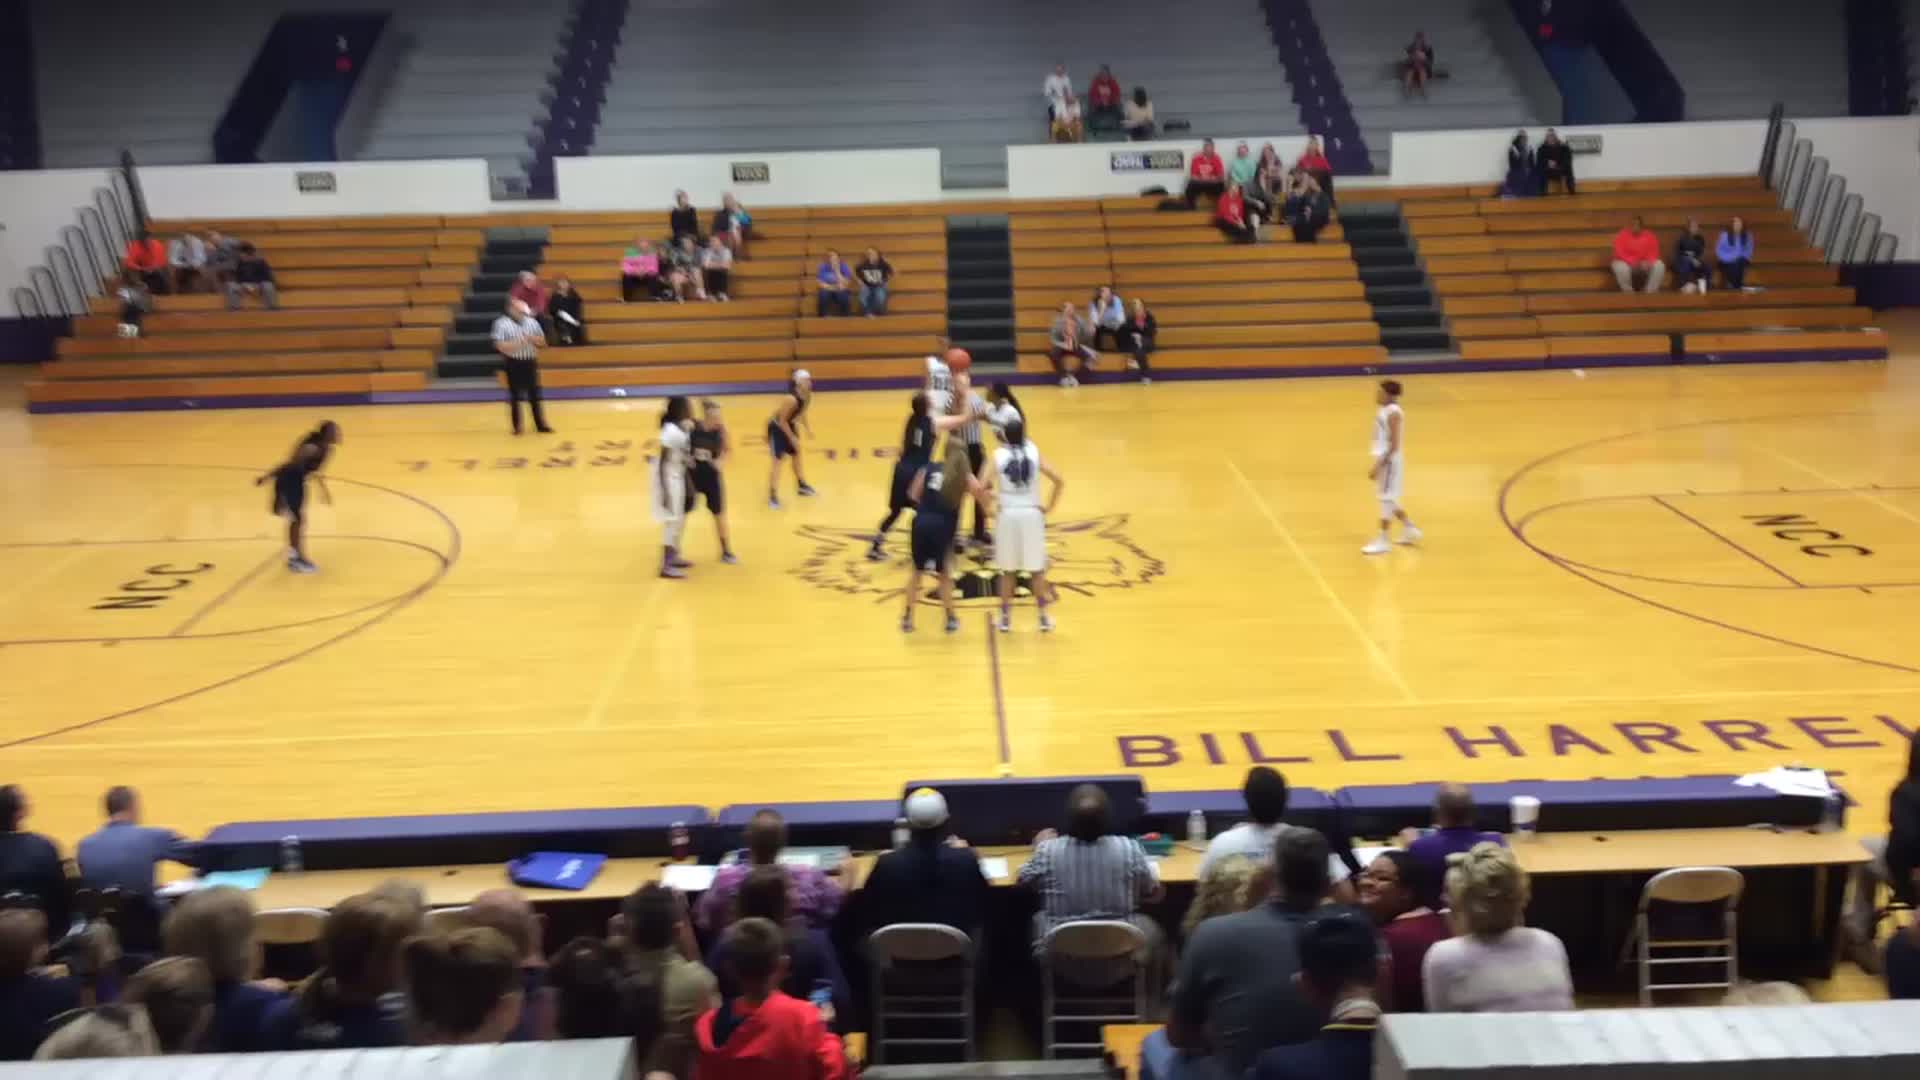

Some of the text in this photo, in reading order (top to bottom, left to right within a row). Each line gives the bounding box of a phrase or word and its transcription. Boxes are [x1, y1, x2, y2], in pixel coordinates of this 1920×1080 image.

[1740, 514, 1876, 558] NCC
[88, 562, 216, 610] NCC
[1115, 729, 1405, 768] BILL
